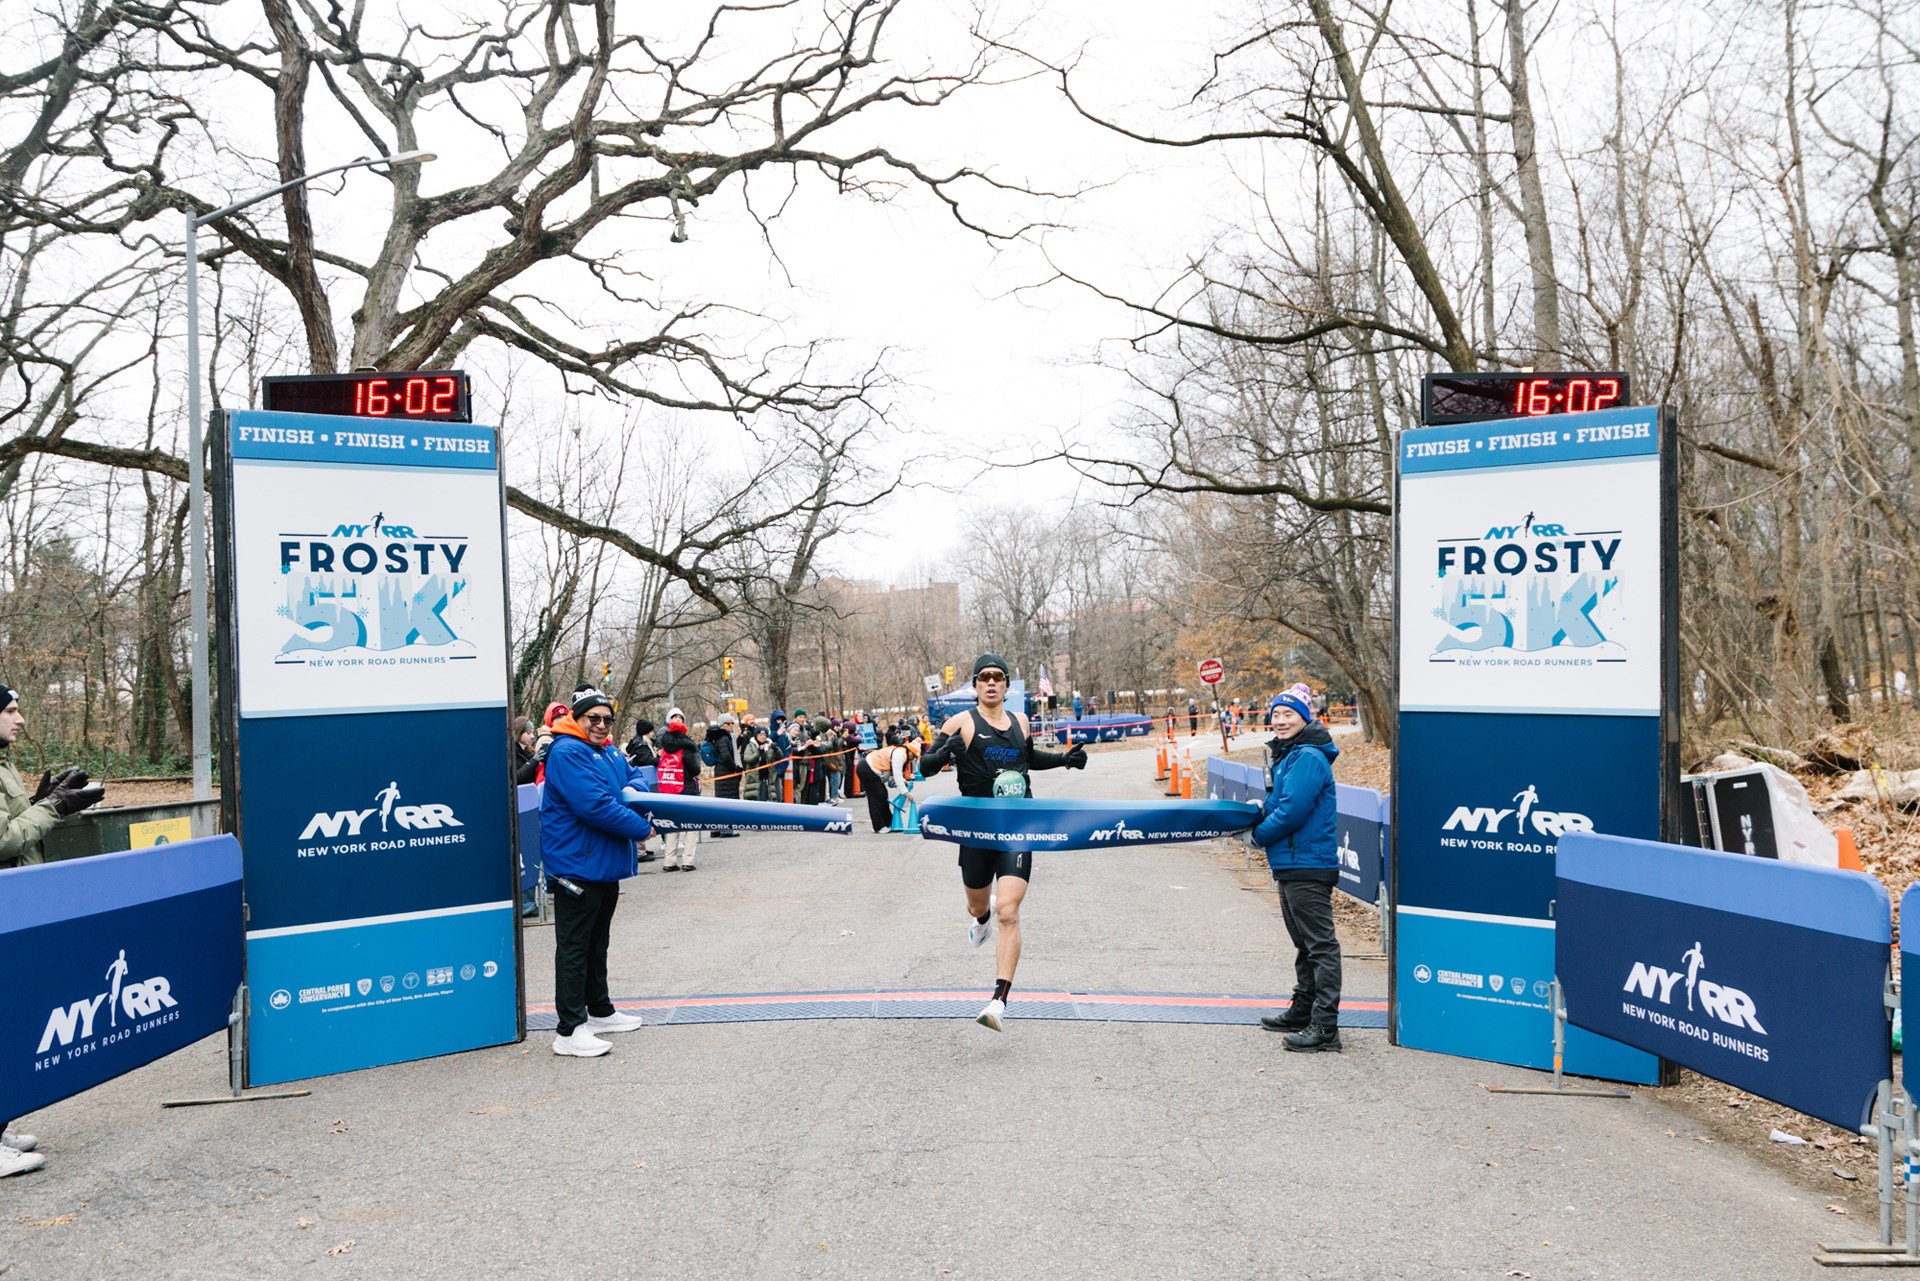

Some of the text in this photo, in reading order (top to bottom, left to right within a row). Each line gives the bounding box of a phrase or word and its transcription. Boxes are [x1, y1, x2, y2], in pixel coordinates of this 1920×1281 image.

[239, 426, 490, 453] FINISH FINISH FINISH
[1406, 422, 1650, 458] FINISH FINISH FINISH
[331, 524, 424, 538] NYRR
[1484, 523, 1569, 540] NYRR
[280, 542, 468, 575] FROSTY
[1438, 539, 1621, 578] FROSTY
[281, 573, 466, 654] 5K
[1435, 571, 1618, 652] 5K
[309, 656, 446, 667] NEW YORK ROAD RUNNERS
[298, 803, 465, 840] NYRR
[652, 819, 679, 829] RR
[824, 821, 852, 831] NY
[927, 824, 951, 836] RR
[952, 829, 971, 838] NEW
[973, 831, 996, 841] YORK
[998, 833, 1024, 841] ROAD
[1026, 833, 1069, 842] RUNNERS
[1089, 829, 1146, 841] NYRR
[1195, 830, 1220, 838] ROAD
[1441, 806, 1597, 837] NYRR
[1740, 813, 1756, 856] NYR
[297, 834, 467, 857] NEW YORK ROAD RUNNERS
[1441, 838, 1468, 848] NEW
[1471, 840, 1504, 851] YORK
[1507, 842, 1542, 854] ROAD
[1437, 969, 1478, 981] CENTRAL PARK
[1437, 976, 1478, 988] CONSERVANCY
[299, 984, 345, 998] CENTRAL PARK
[299, 990, 345, 1004] CONSERVANCY
[1623, 961, 1768, 1035] NYRR
[36, 976, 179, 1055] NYRR
[35, 1010, 180, 1072] NEW YORK ROAD RUNNERS
[1622, 1002, 1769, 1062] NEW YORK ROAD RUNNERS
